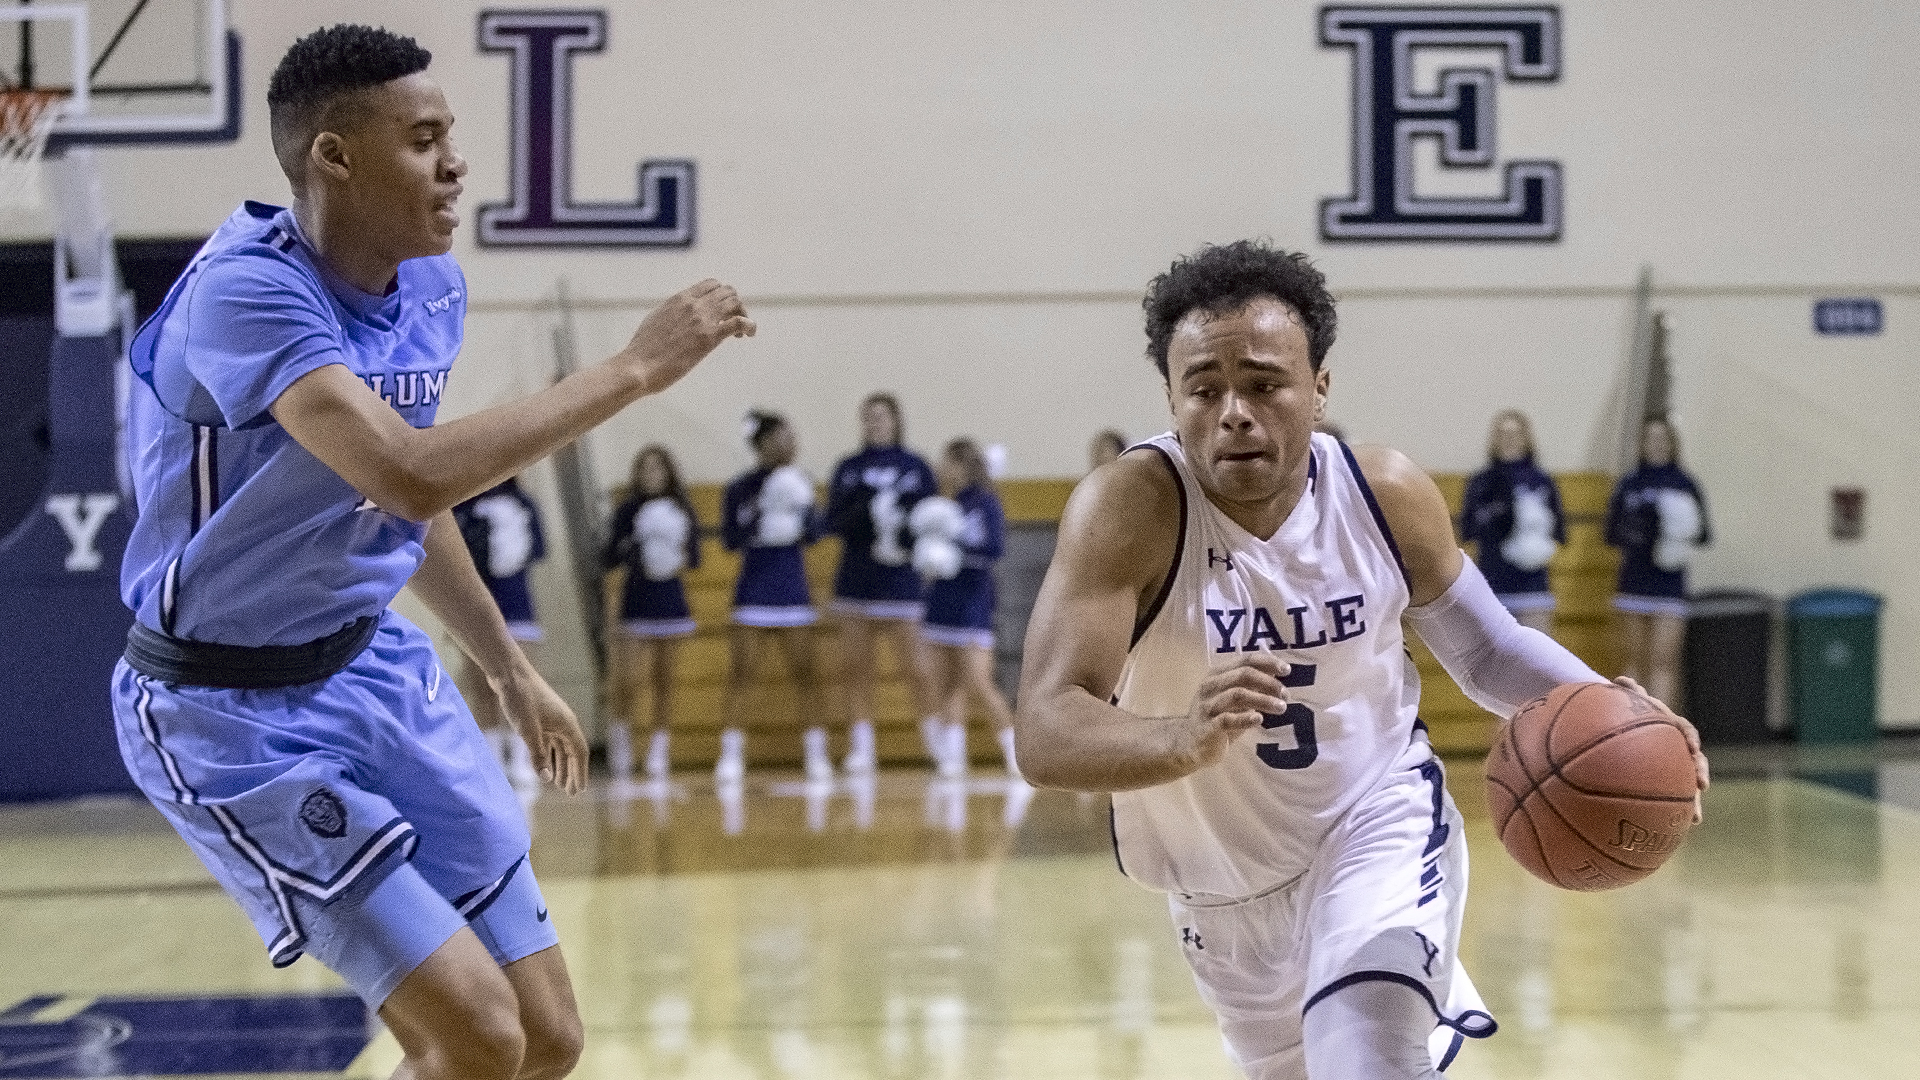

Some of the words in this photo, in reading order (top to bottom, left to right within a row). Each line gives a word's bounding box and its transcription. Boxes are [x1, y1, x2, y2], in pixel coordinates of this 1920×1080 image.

[476, 9, 697, 249] L
[1319, 5, 1563, 243] E
[45, 494, 119, 571] Y
[1206, 594, 1366, 653] YALE
[1256, 663, 1319, 769] 5
